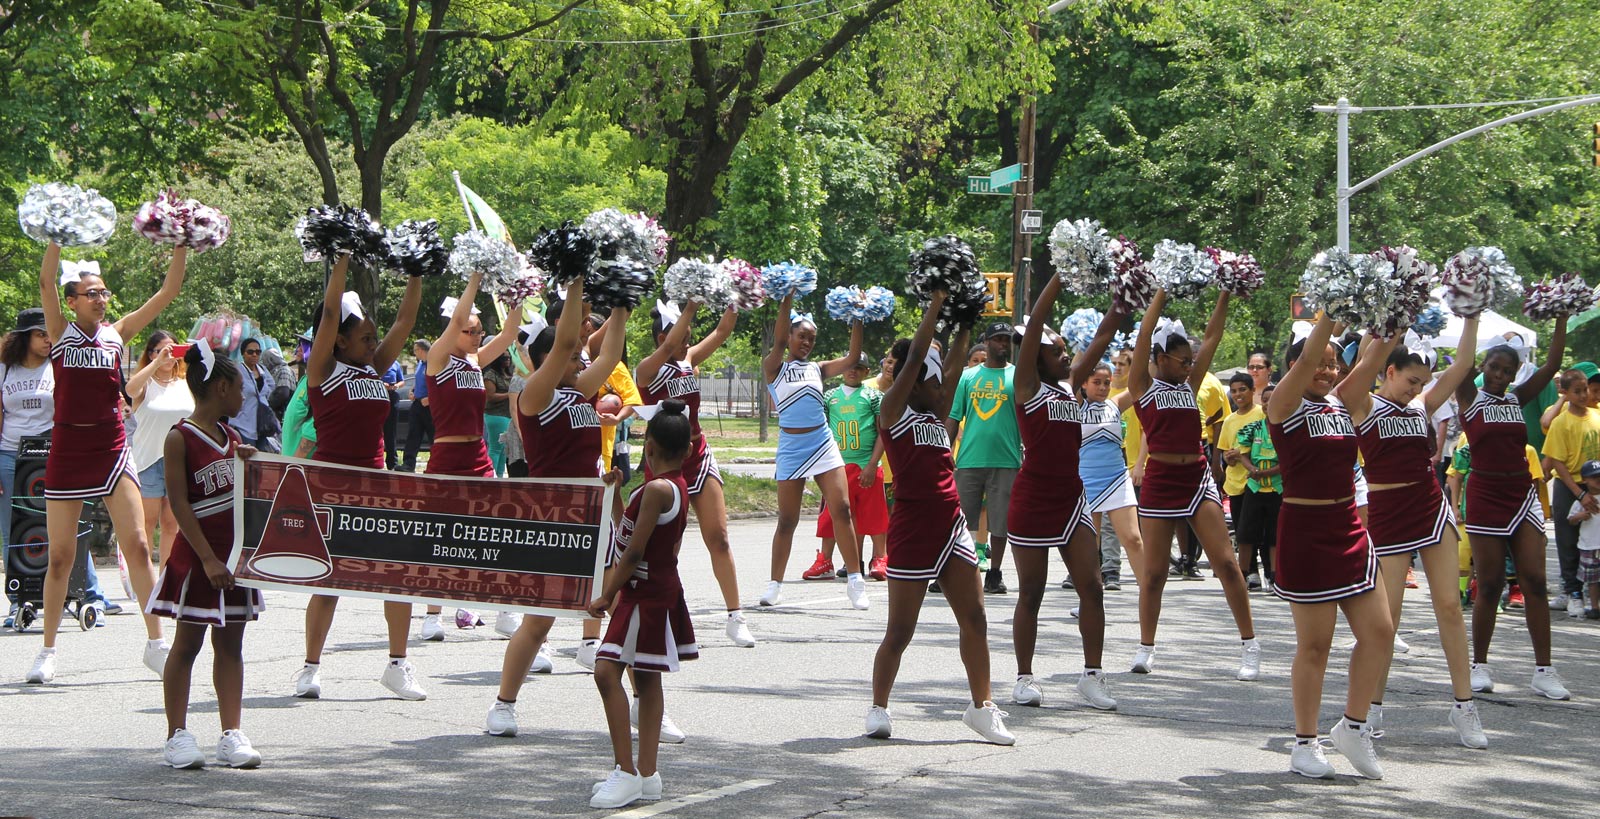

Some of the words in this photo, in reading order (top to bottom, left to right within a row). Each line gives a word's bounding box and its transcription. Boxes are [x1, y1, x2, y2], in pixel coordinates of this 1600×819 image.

[63, 346, 116, 369] ROOSEVELT
[22, 398, 42, 410] CHEER
[970, 391, 1008, 401] DUCKS
[1155, 391, 1197, 410] ROOSEVEL
[837, 420, 860, 450] 99
[321, 492, 426, 511] SPIRIT
[467, 499, 586, 524] POMS
[282, 517, 305, 528] TREC
[338, 513, 446, 538] ROOSEVELT
[452, 522, 593, 550] CHEERLEADING
[432, 544, 478, 560] BRONX,
[482, 548, 501, 561] NY
[337, 558, 519, 585] SPIRIT
[402, 577, 430, 588] GO
[436, 579, 496, 593] FIGHT
[500, 584, 540, 597] WIN
